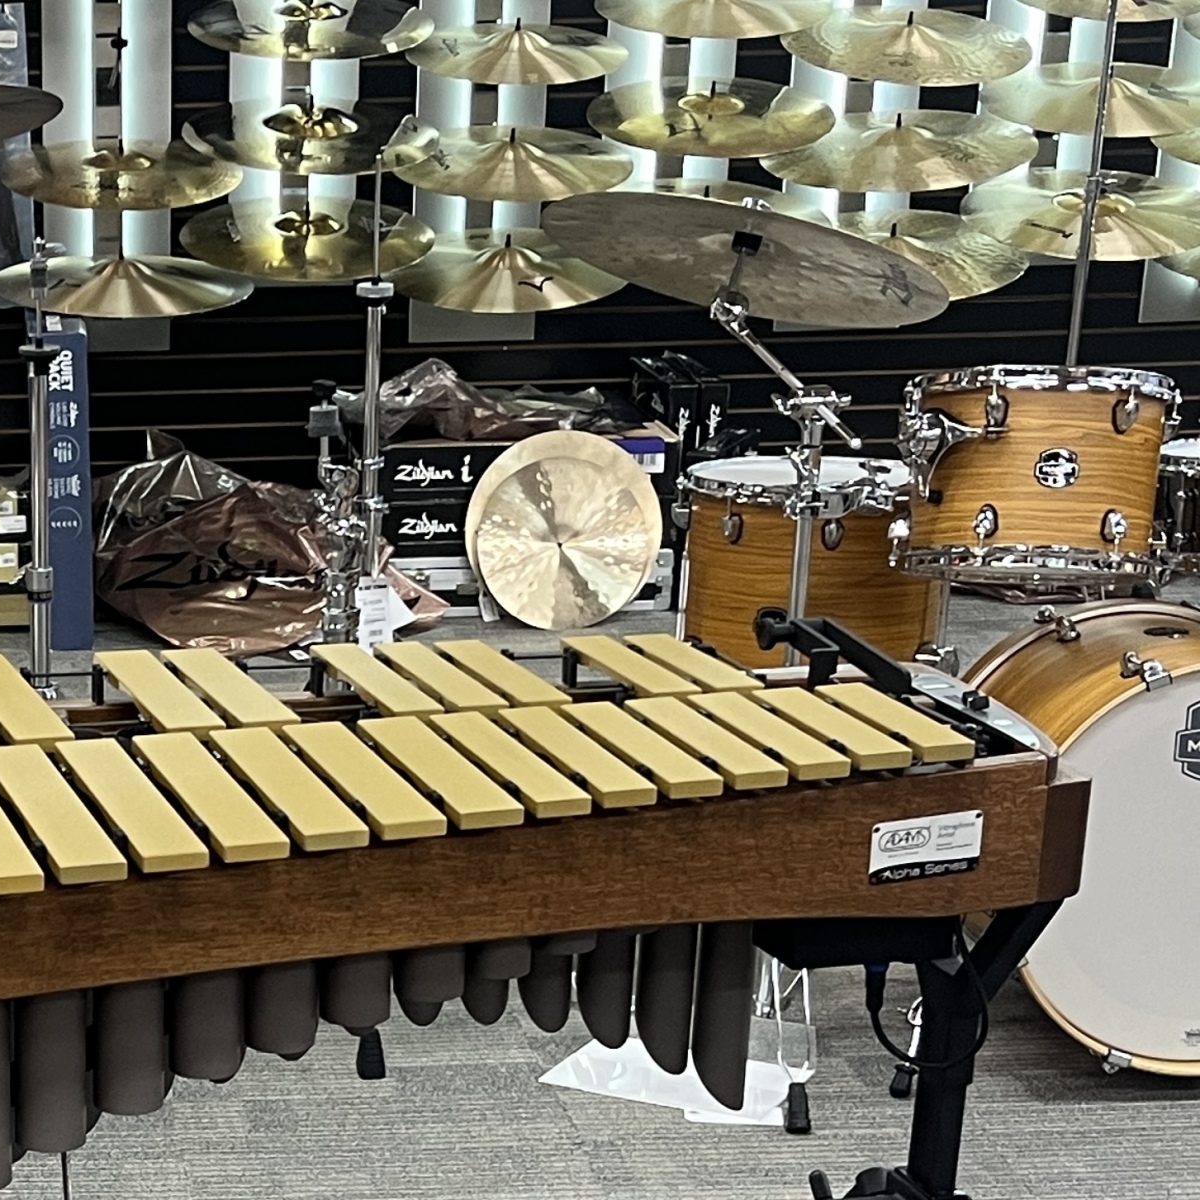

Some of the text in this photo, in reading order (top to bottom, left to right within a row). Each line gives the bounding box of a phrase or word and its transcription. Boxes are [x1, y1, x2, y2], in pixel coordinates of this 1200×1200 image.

[60, 349, 74, 392] QUIET
[393, 458, 455, 487] Zildjian
[398, 511, 458, 540] Zildjian
